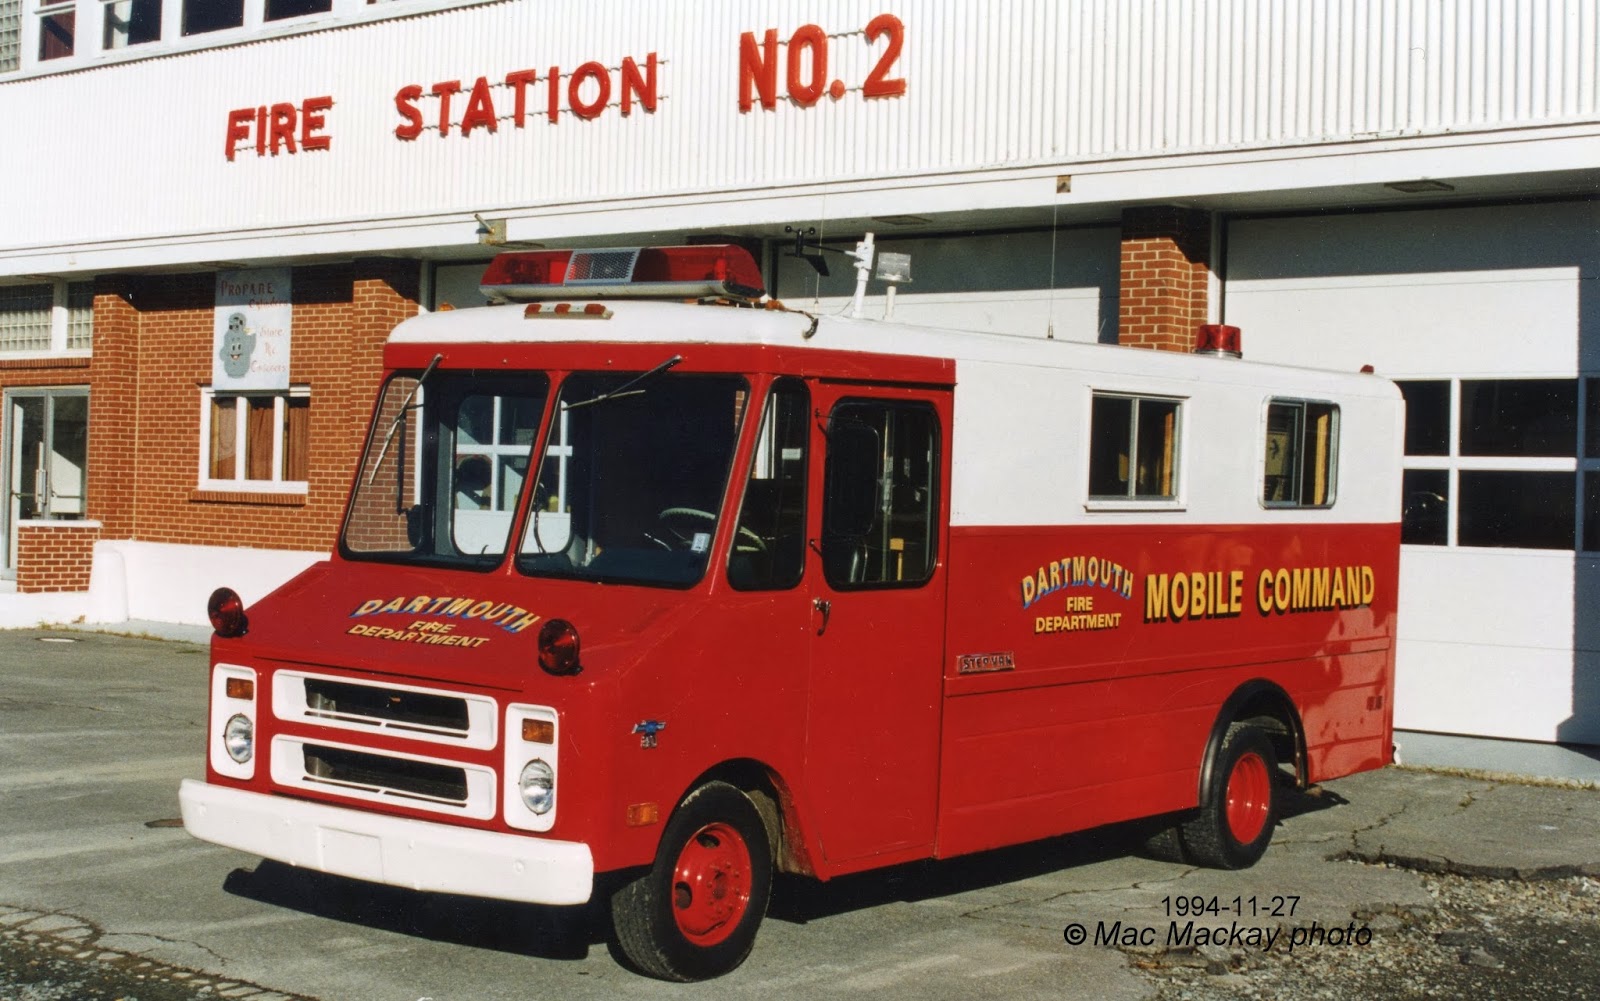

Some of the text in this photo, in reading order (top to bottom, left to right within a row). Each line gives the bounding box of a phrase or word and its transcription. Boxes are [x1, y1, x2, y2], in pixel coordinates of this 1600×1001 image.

[225, 95, 333, 162] FIRE
[395, 52, 657, 140] STATION
[1021, 556, 1134, 609] DARTMOUTH
[1145, 566, 1376, 623] MOBILE COMMAND
[350, 595, 541, 633] DARTMOUTH
[1066, 596, 1094, 612] FIRE
[347, 624, 491, 648] DEPARTMENT
[406, 620, 457, 634] FIRE
[1035, 613, 1122, 634] DEPARTMENT
